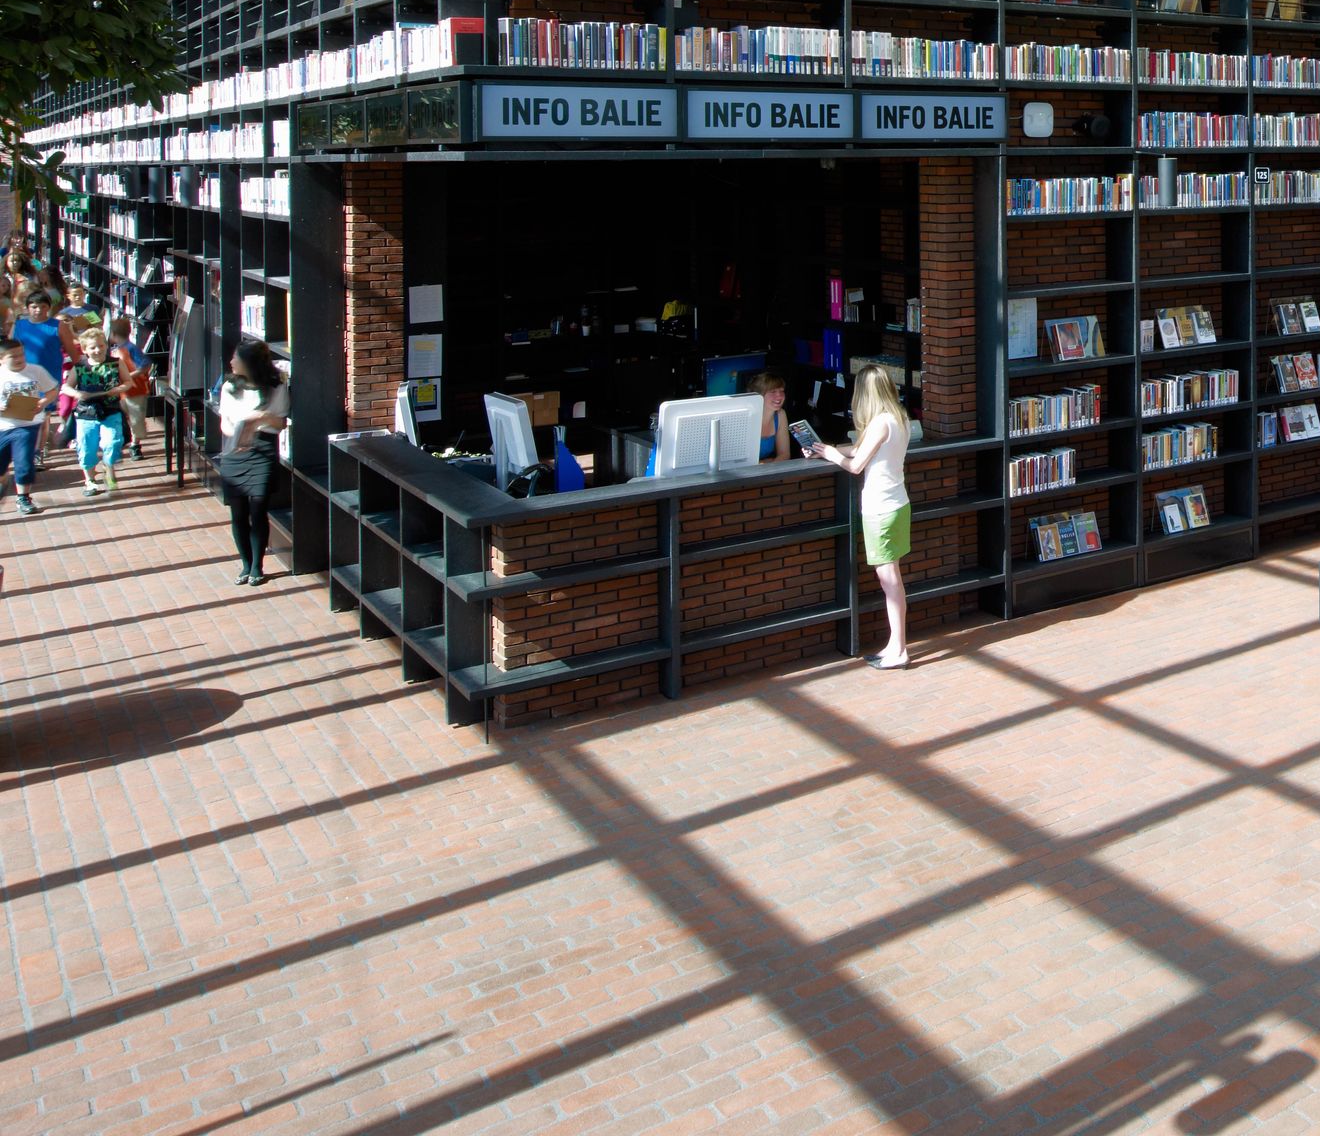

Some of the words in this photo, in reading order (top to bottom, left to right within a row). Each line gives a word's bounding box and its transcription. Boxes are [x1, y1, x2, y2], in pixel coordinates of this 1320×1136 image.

[502, 97, 570, 126] INFO
[580, 98, 662, 127] BALIE
[704, 102, 761, 128] INFO
[770, 103, 841, 129] BALIE
[876, 105, 926, 130] INFO
[933, 106, 994, 131] BALIE
[1256, 171, 1268, 180] 125
